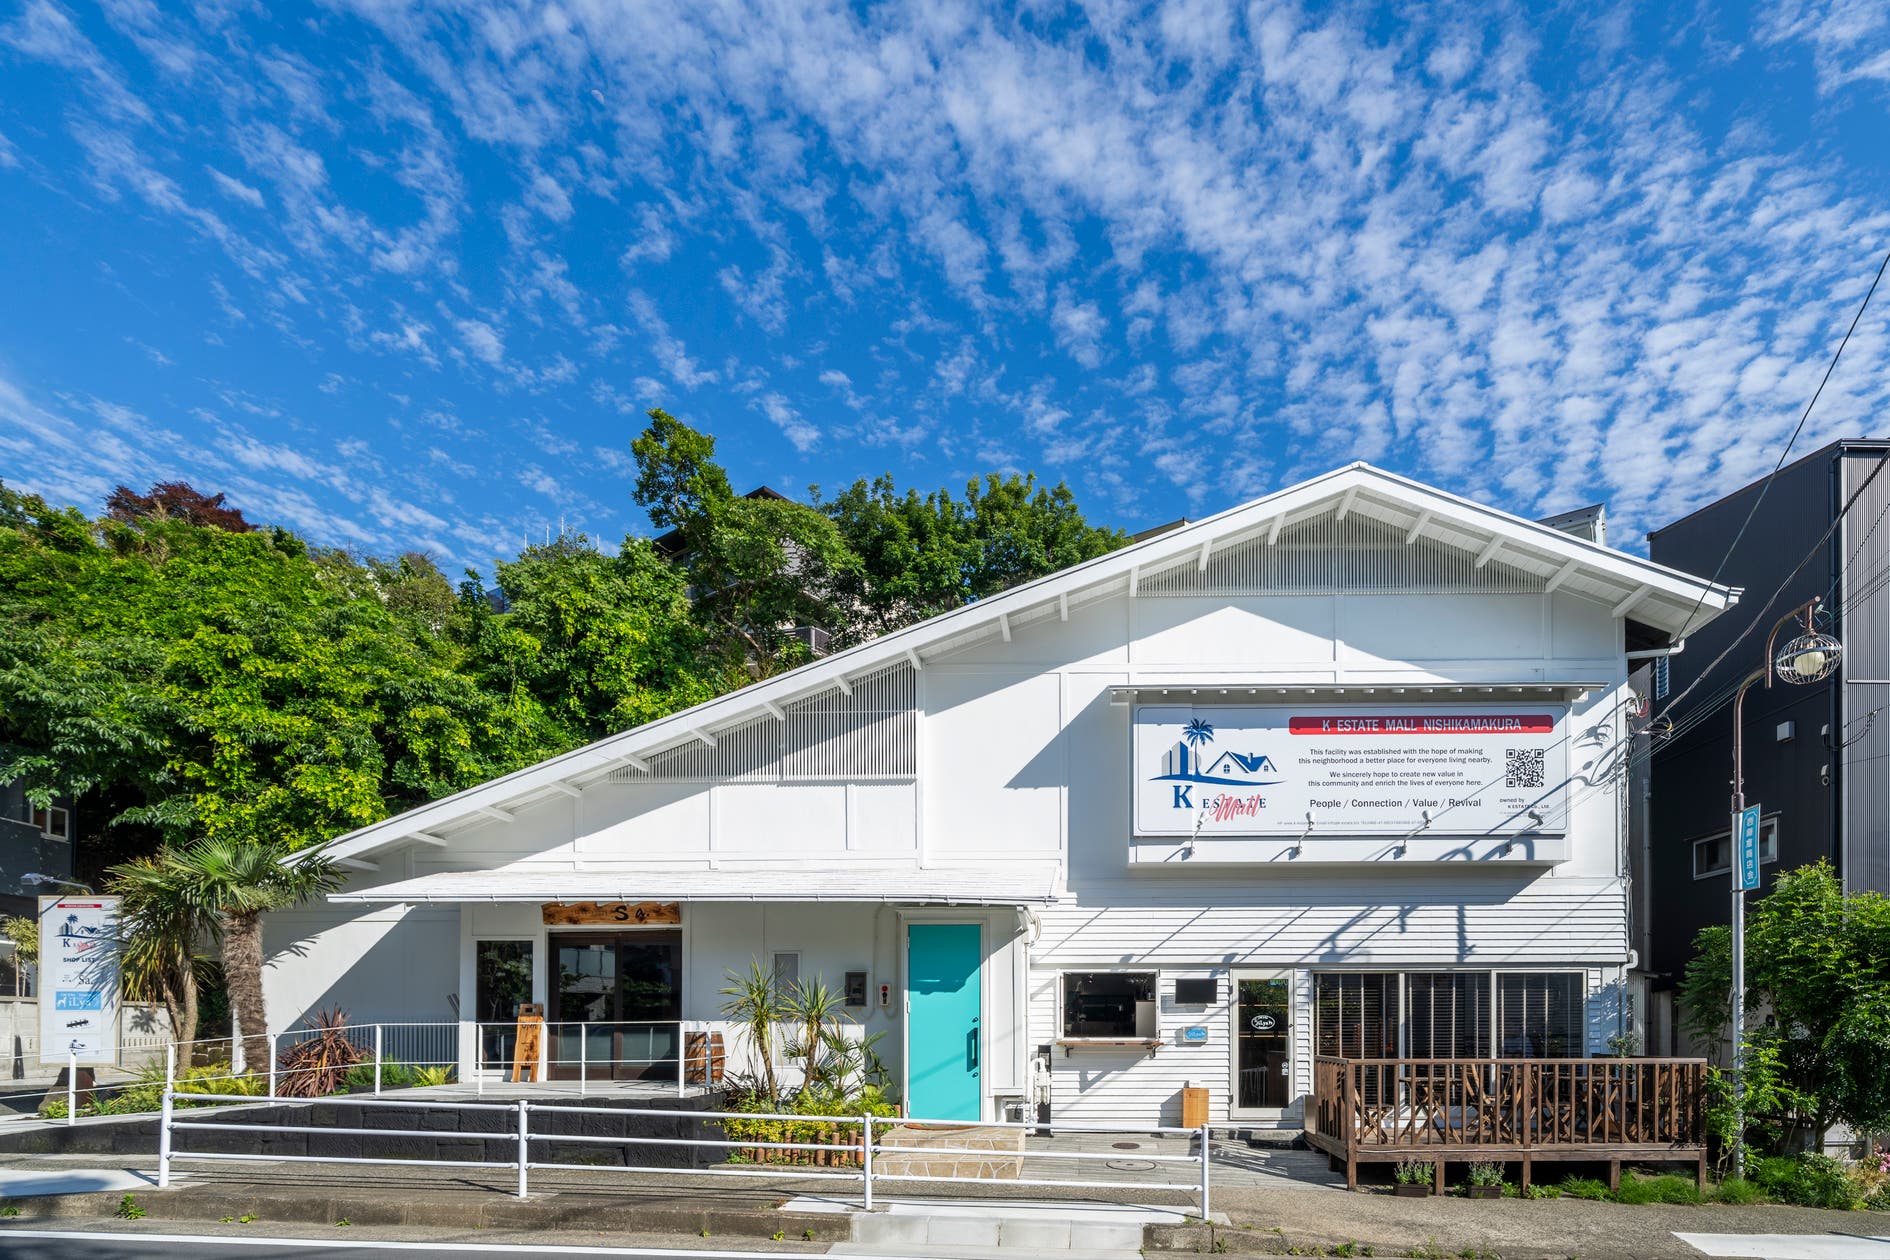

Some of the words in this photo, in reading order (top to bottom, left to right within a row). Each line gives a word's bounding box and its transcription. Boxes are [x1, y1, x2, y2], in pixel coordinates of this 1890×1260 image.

[1322, 719, 1331, 732] K
[1336, 719, 1379, 731] ESTATE
[1385, 719, 1417, 731] MALL
[1423, 718, 1522, 731] NISHIKAMAKURA
[1324, 748, 1347, 756] facility
[1430, 748, 1447, 756] hope
[1457, 748, 1483, 756] making
[1386, 757, 1405, 765] place
[1448, 757, 1466, 765] living
[1467, 757, 1492, 765] nearby.
[1372, 771, 1389, 779] hope
[1321, 780, 1359, 788] community
[1172, 785, 1194, 808] K
[1202, 798, 1267, 809] ESTATE
[1208, 793, 1261, 823] Mall
[1309, 799, 1341, 809] People
[1351, 799, 1403, 808] Connection
[1412, 798, 1438, 807] Value
[1448, 798, 1481, 807] Revival
[63, 938, 70, 948] K
